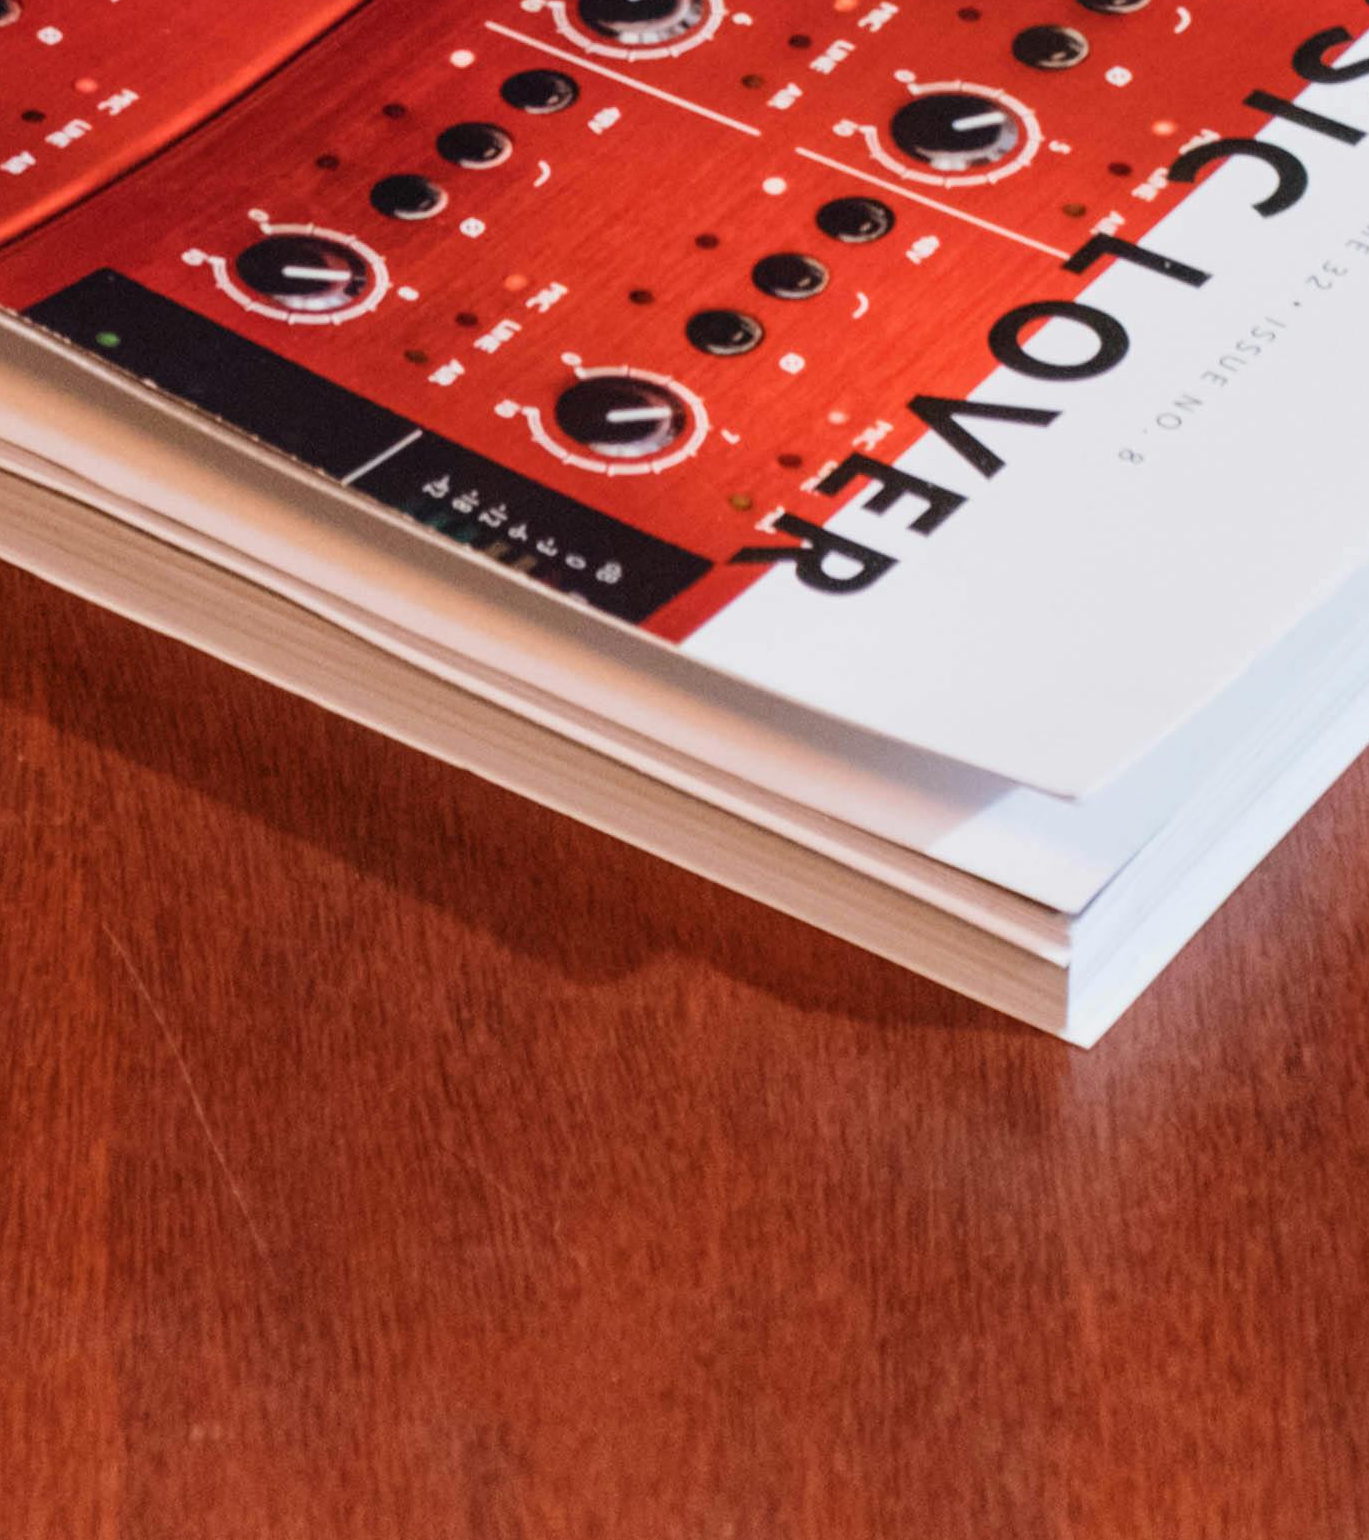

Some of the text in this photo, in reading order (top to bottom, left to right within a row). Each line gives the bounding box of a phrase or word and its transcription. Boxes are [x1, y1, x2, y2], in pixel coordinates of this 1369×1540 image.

[1303, 261, 1348, 294] 32
[1202, 317, 1288, 388] ISSUE
[727, 232, 1213, 596] LOVER
[1143, 393, 1203, 435] NO.
[1118, 447, 1145, 467] 8
